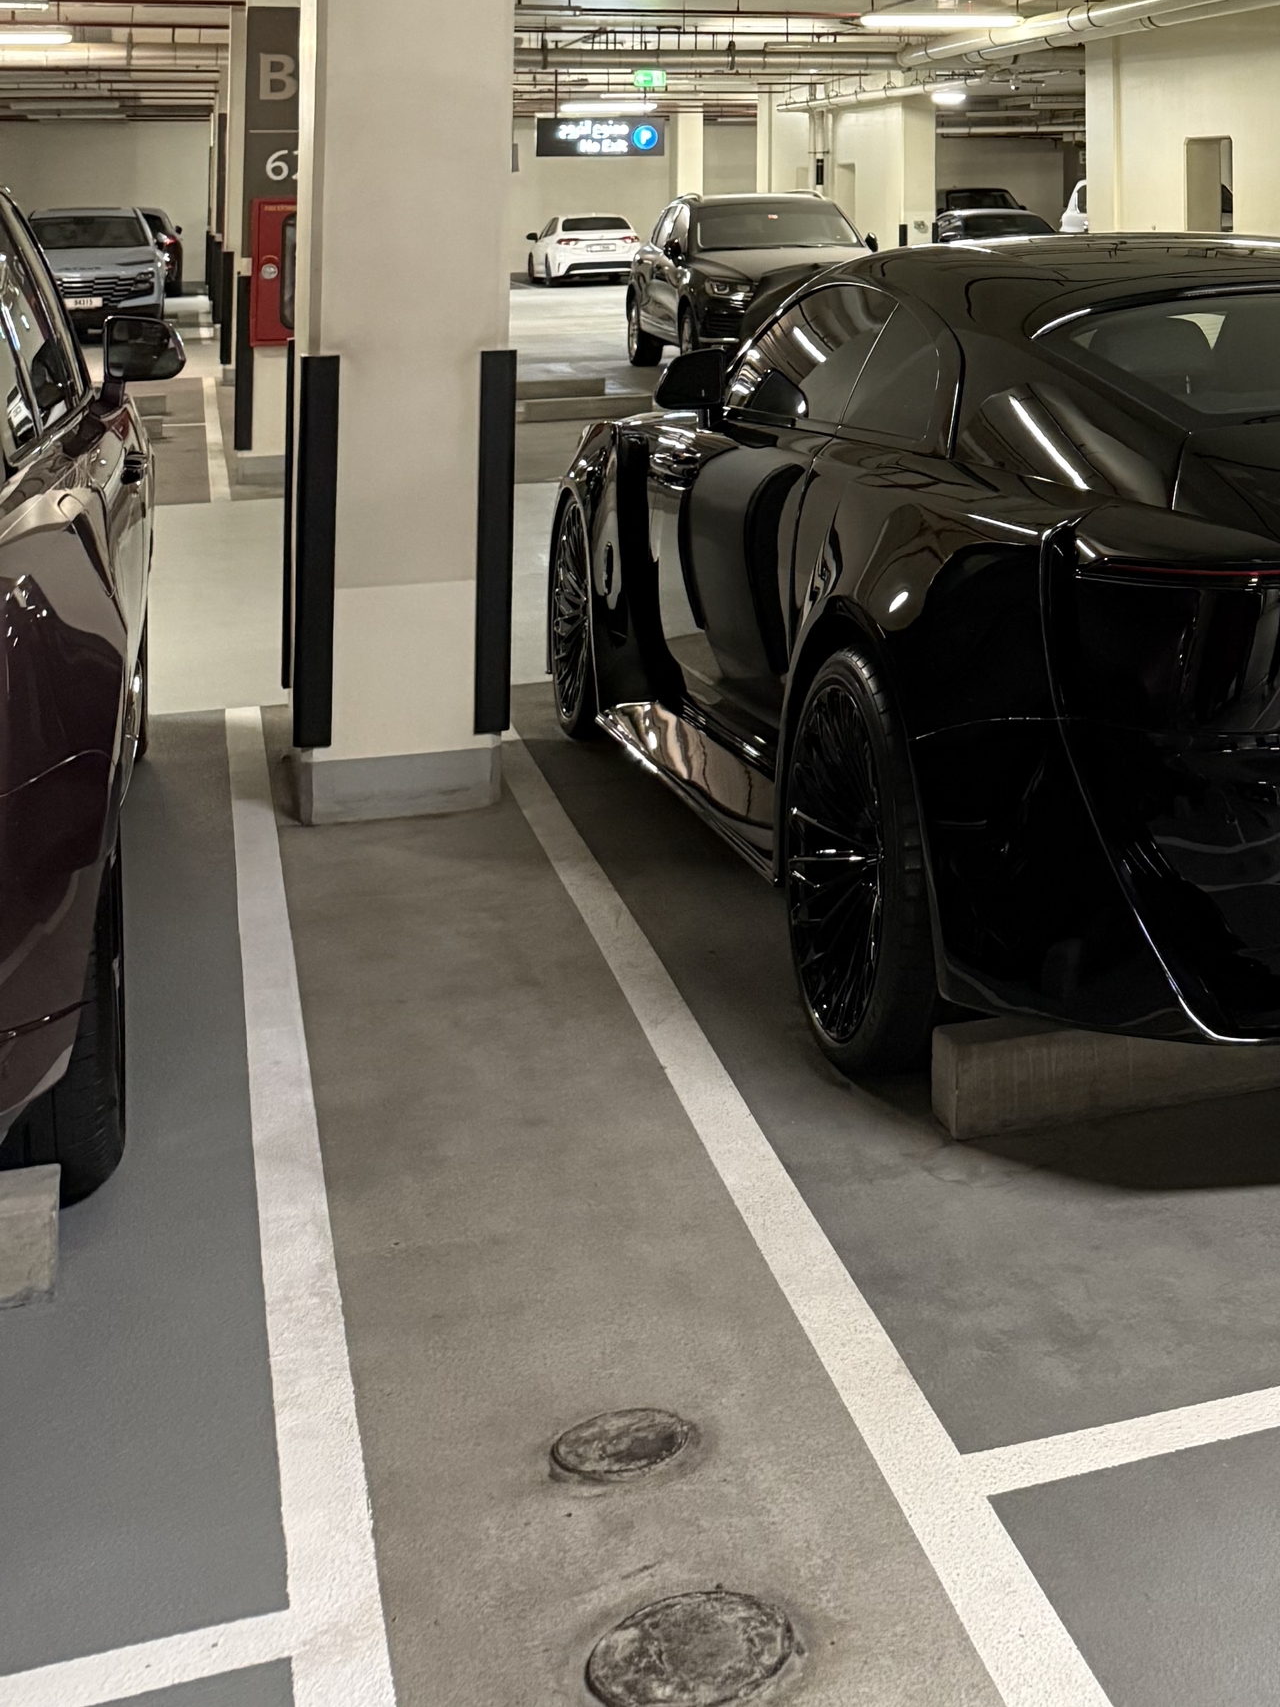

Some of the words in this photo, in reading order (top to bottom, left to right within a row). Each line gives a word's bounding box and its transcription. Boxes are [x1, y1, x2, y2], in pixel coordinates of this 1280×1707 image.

[259, 52, 298, 100] B
[579, 139, 600, 152] No
[601, 139, 628, 152] Exit
